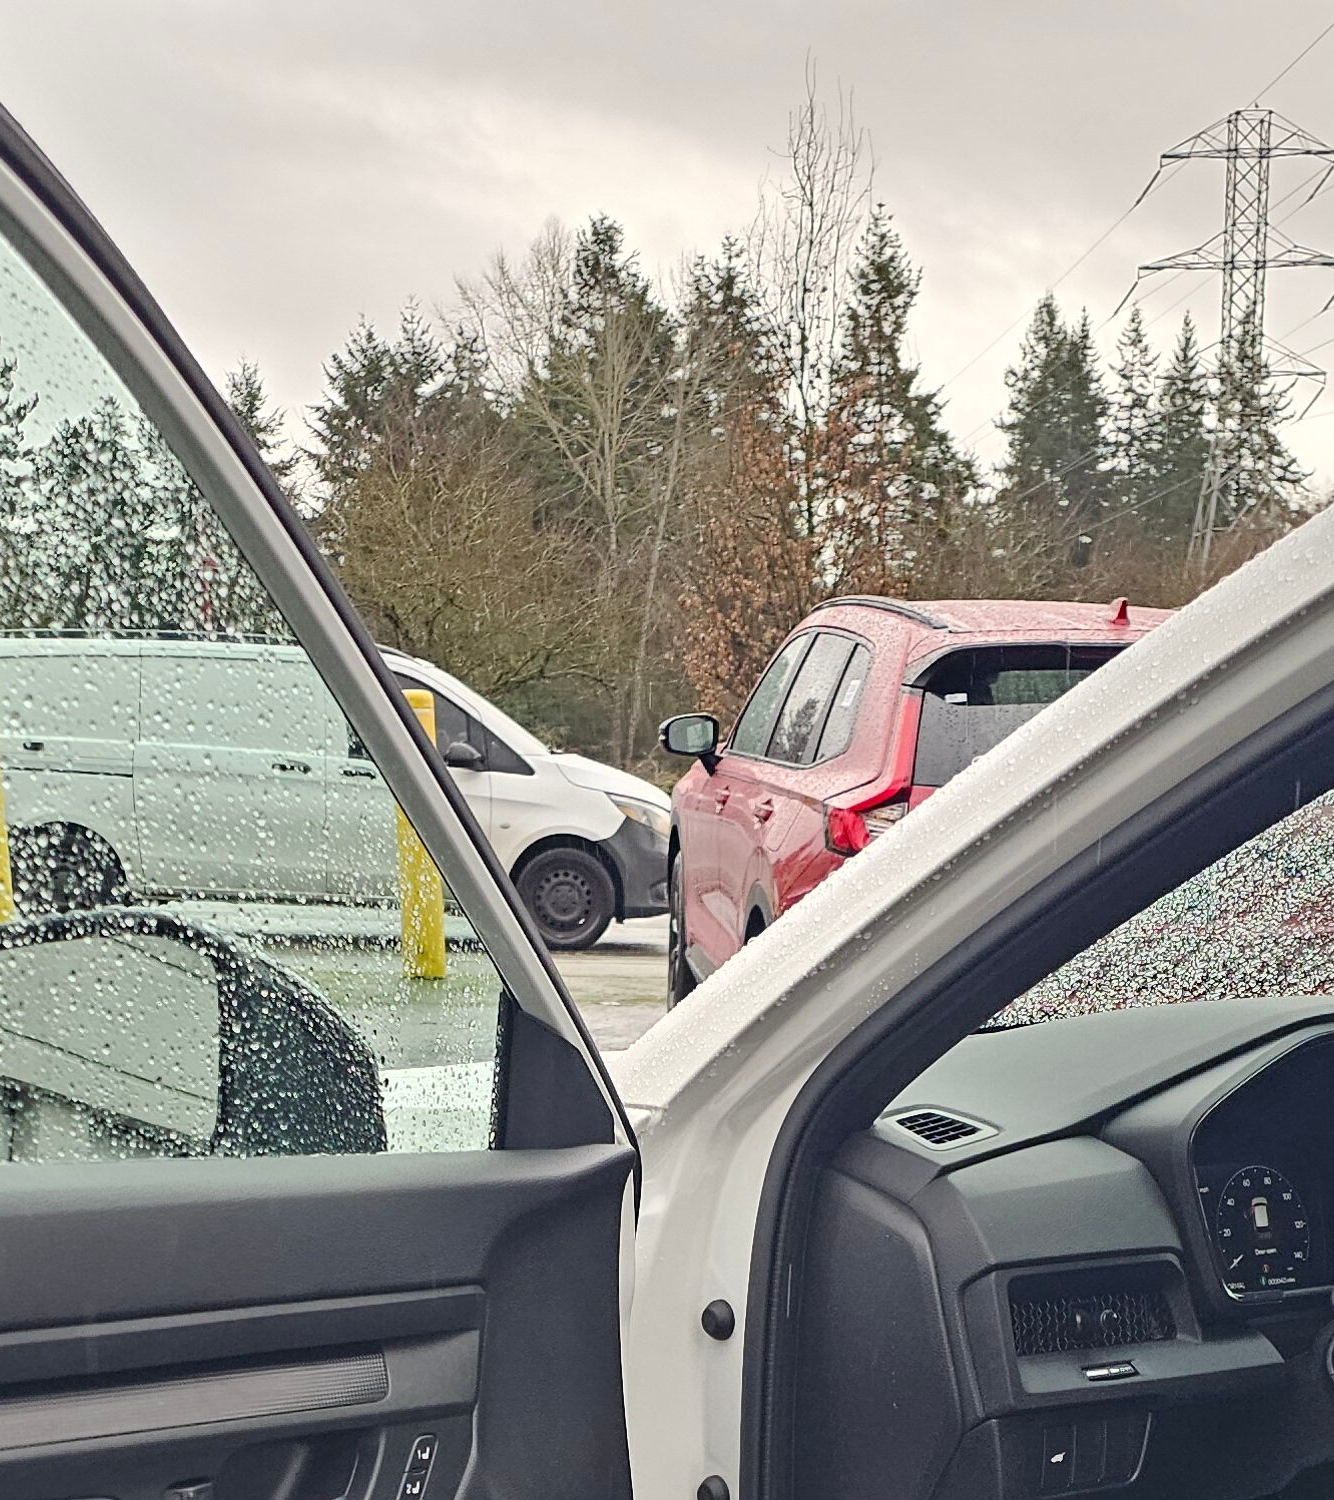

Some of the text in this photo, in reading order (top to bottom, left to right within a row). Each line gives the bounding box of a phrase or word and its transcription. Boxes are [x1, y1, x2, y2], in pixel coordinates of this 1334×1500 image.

[1242, 1179, 1251, 1187] 60
[1282, 1193, 1292, 1201] 100
[1226, 1198, 1235, 1206] 40
[1294, 1221, 1304, 1229] 120
[1223, 1228, 1231, 1237] 20
[1293, 1251, 1304, 1259] 140
